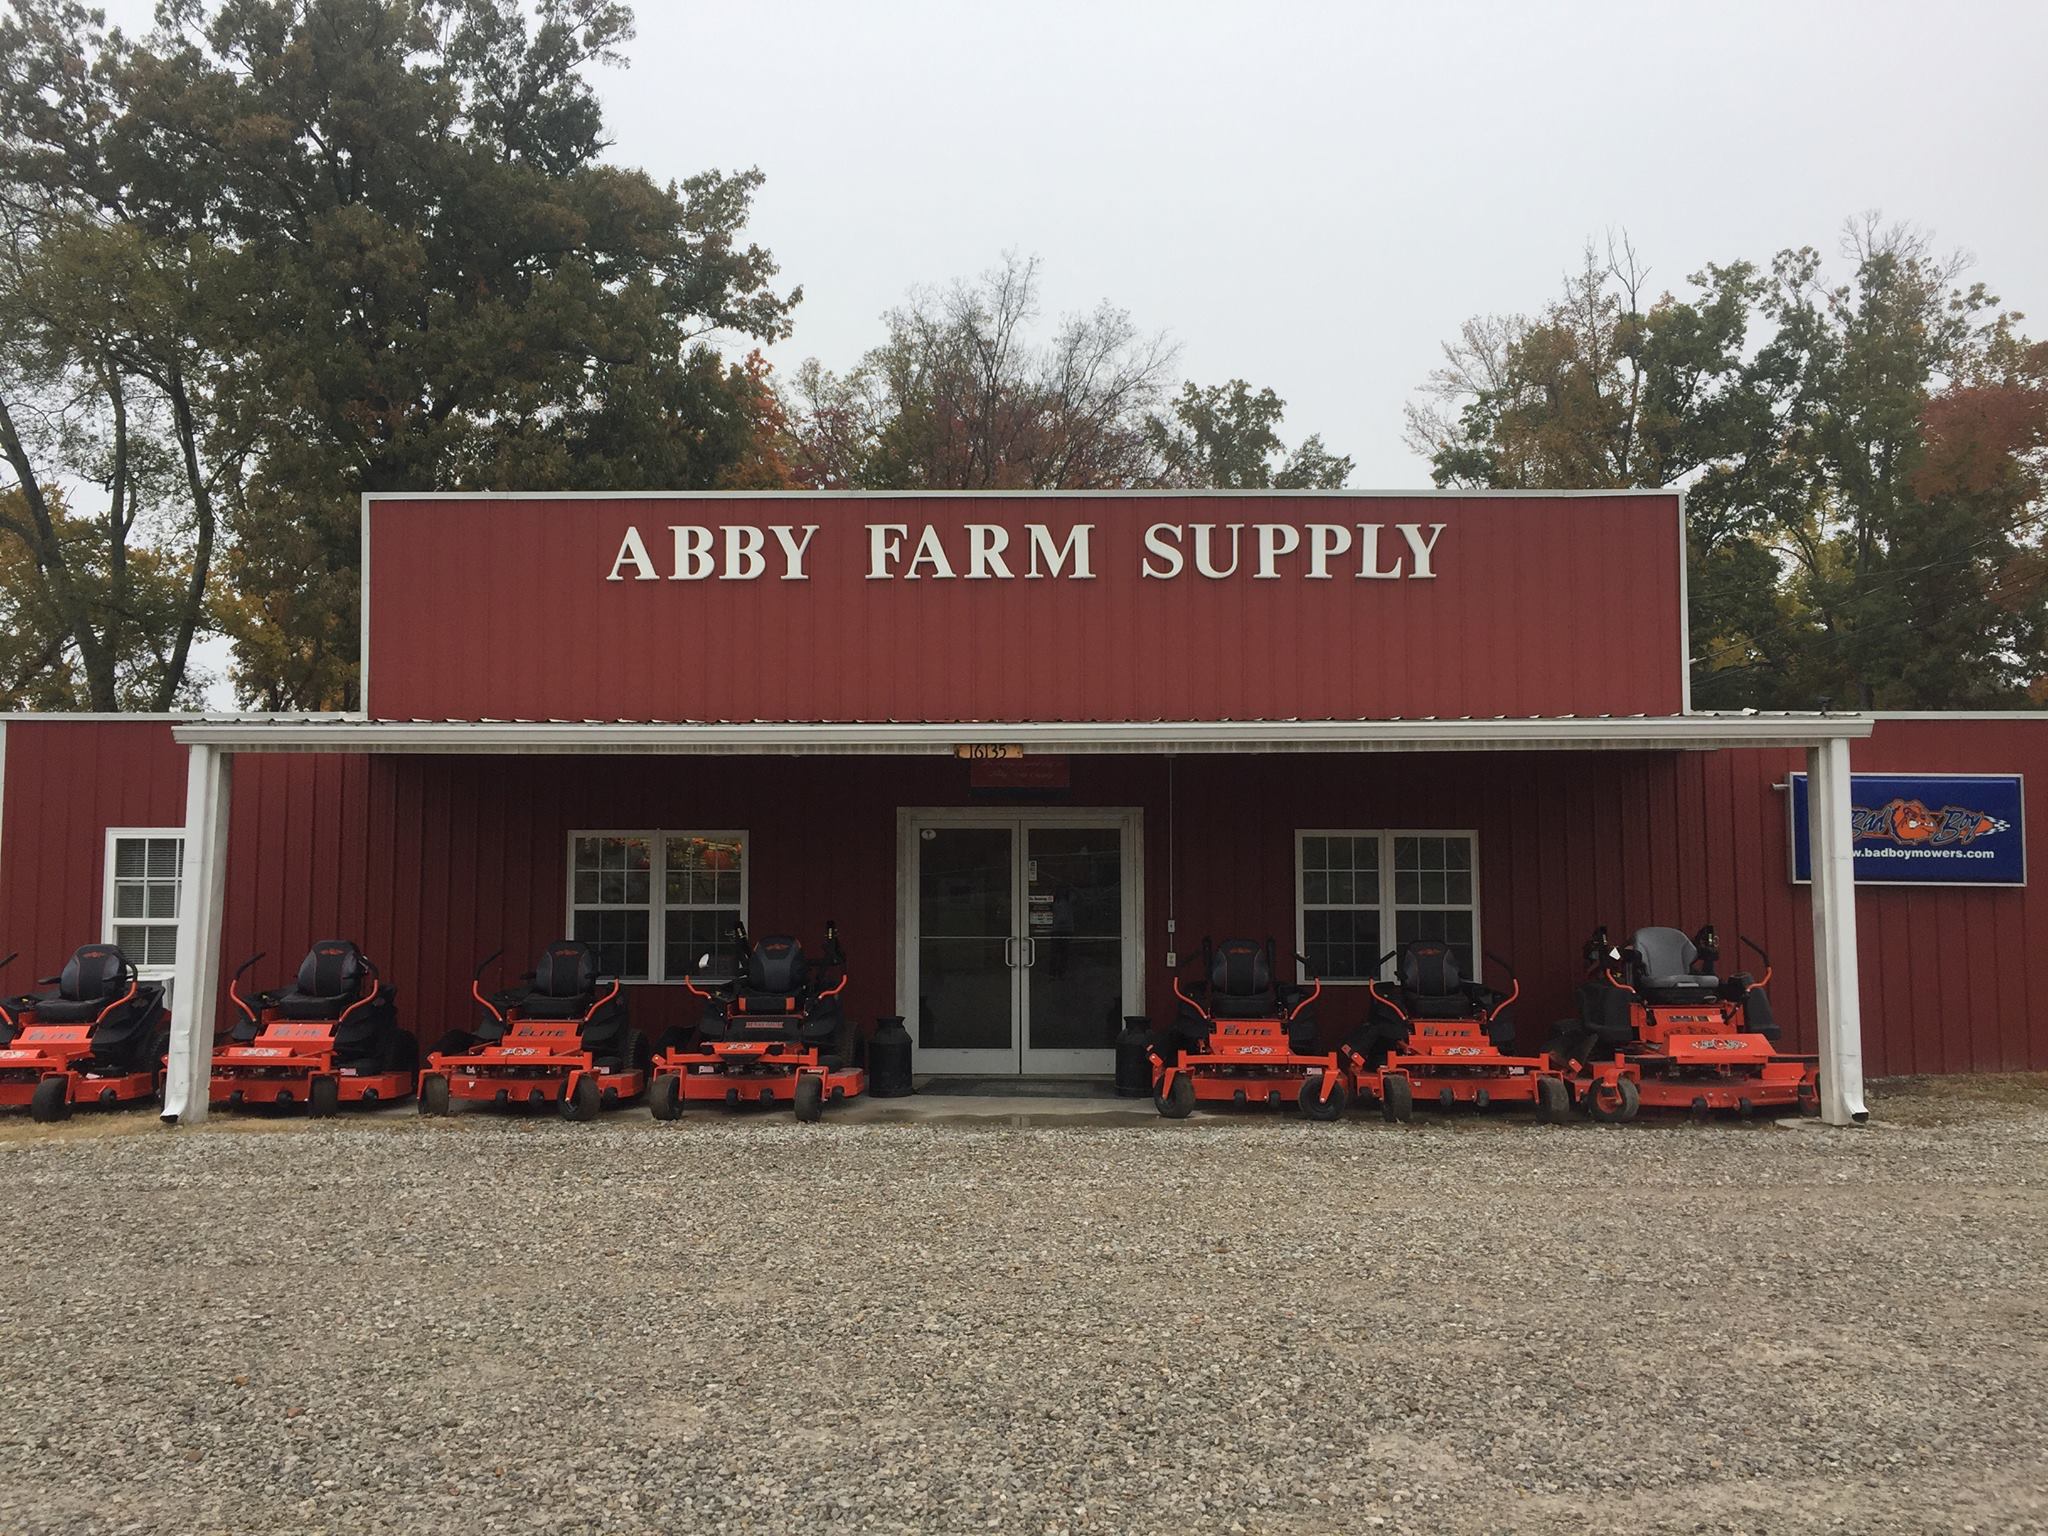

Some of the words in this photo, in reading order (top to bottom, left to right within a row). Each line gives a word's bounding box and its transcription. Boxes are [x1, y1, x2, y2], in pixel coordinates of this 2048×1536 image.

[606, 525, 820, 581] ABBY
[866, 523, 1096, 580] FARM
[1142, 523, 1447, 580] SUPPLY
[1931, 806, 1982, 843] Boy
